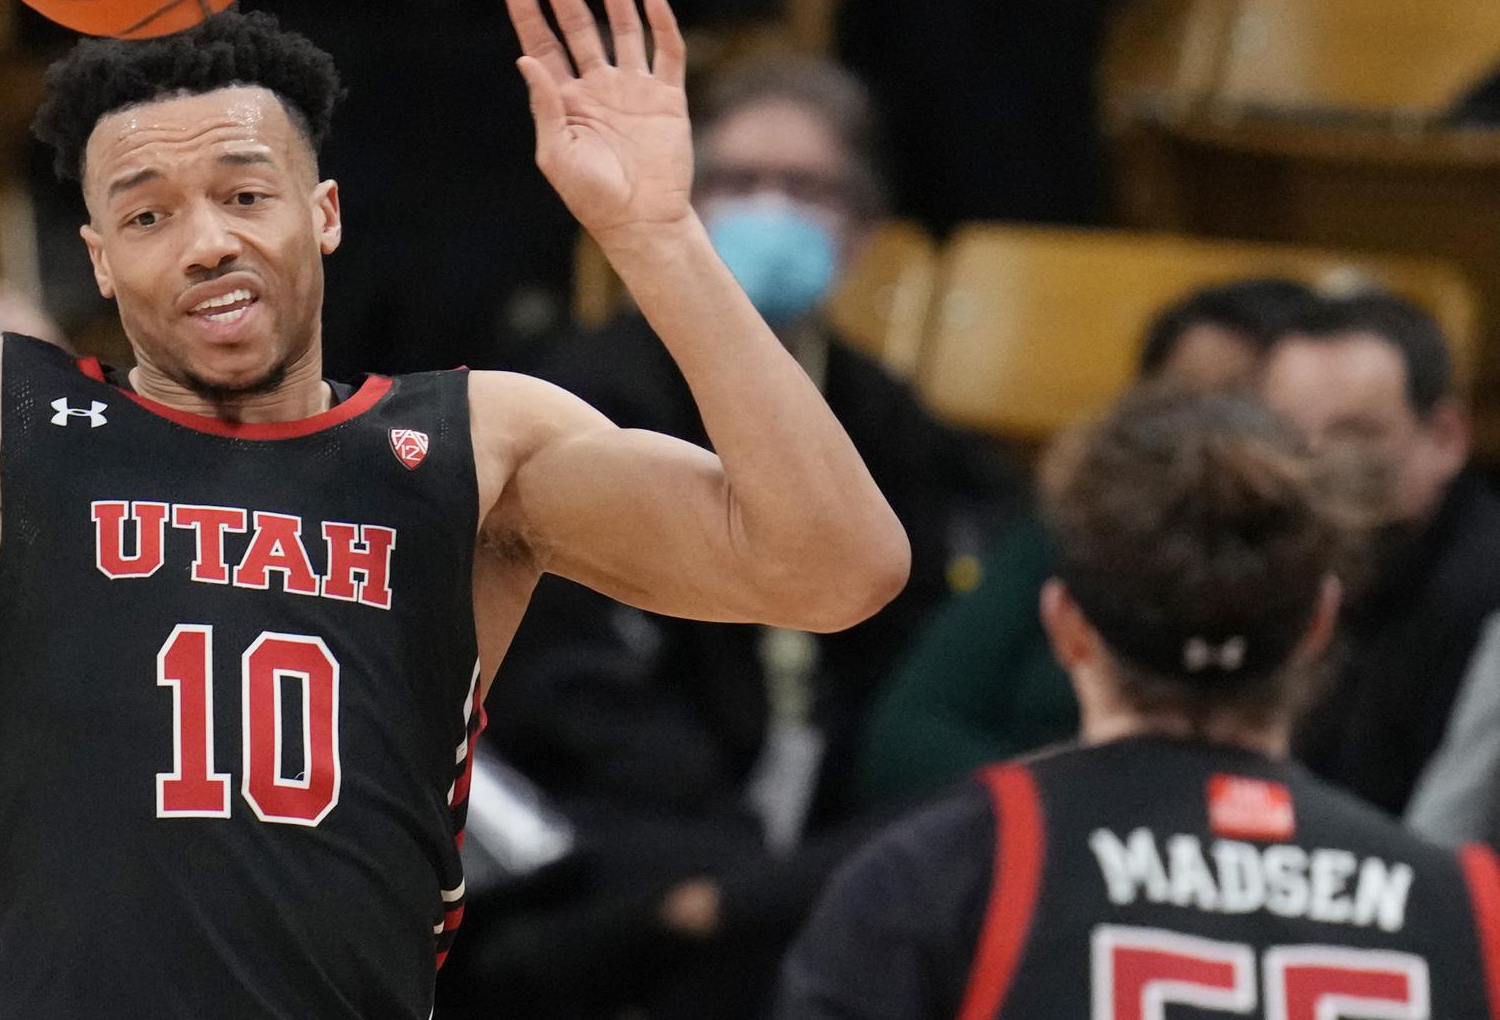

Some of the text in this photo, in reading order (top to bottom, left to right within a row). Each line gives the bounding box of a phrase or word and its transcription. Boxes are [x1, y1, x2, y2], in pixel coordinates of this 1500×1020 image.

[401, 444, 421, 461] 12
[91, 500, 397, 610] UTAH
[156, 623, 341, 827] 10
[1088, 827, 1414, 932] MADSEN
